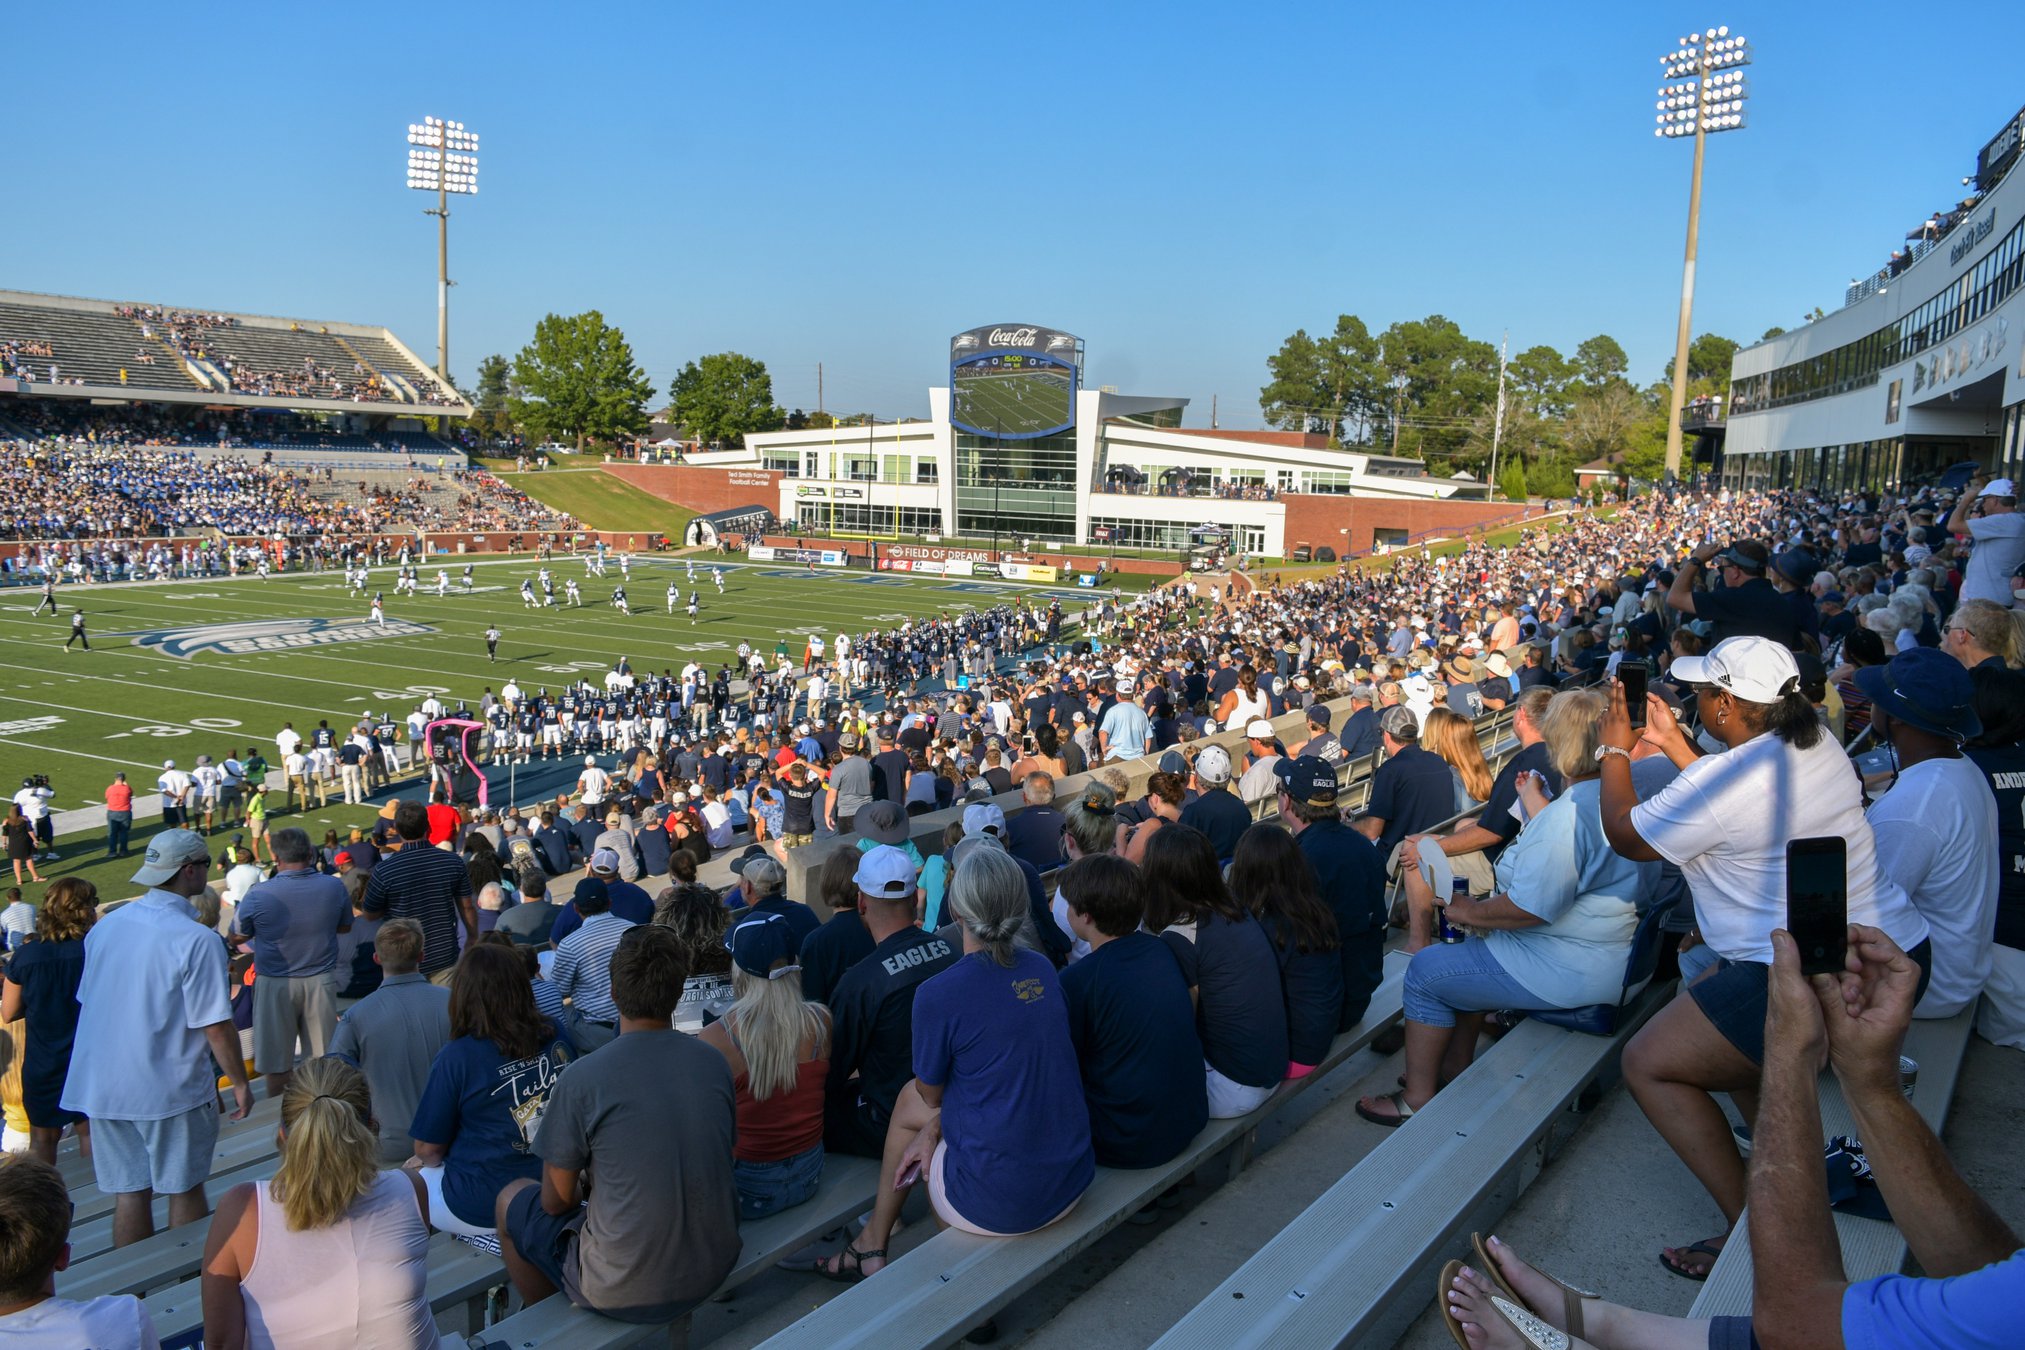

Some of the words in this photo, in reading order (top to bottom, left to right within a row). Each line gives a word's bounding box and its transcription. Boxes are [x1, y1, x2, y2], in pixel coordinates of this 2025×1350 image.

[988, 328, 1039, 347] Coca-Cola
[738, 471, 753, 479] Smith
[753, 472, 771, 480] Family
[905, 547, 929, 558] FIELD
[931, 548, 945, 560] OF
[948, 550, 988, 562] DREAMS
[533, 661, 608, 673] 50
[372, 685, 451, 699] 40
[564, 699, 575, 709] 66
[545, 709, 556, 719] 70
[627, 706, 634, 716] 9
[655, 705, 662, 715] 6
[728, 710, 737, 719] 17
[132, 717, 243, 737] 30
[381, 728, 394, 738] 97
[689, 732, 698, 742] 16
[318, 733, 329, 745] 15
[788, 789, 812, 799] EAGLES
[881, 939, 951, 976] EAGLES
[680, 991, 703, 1003] ORGIA
[499, 1065, 517, 1076] RISE
[516, 1099, 539, 1119] GATA
